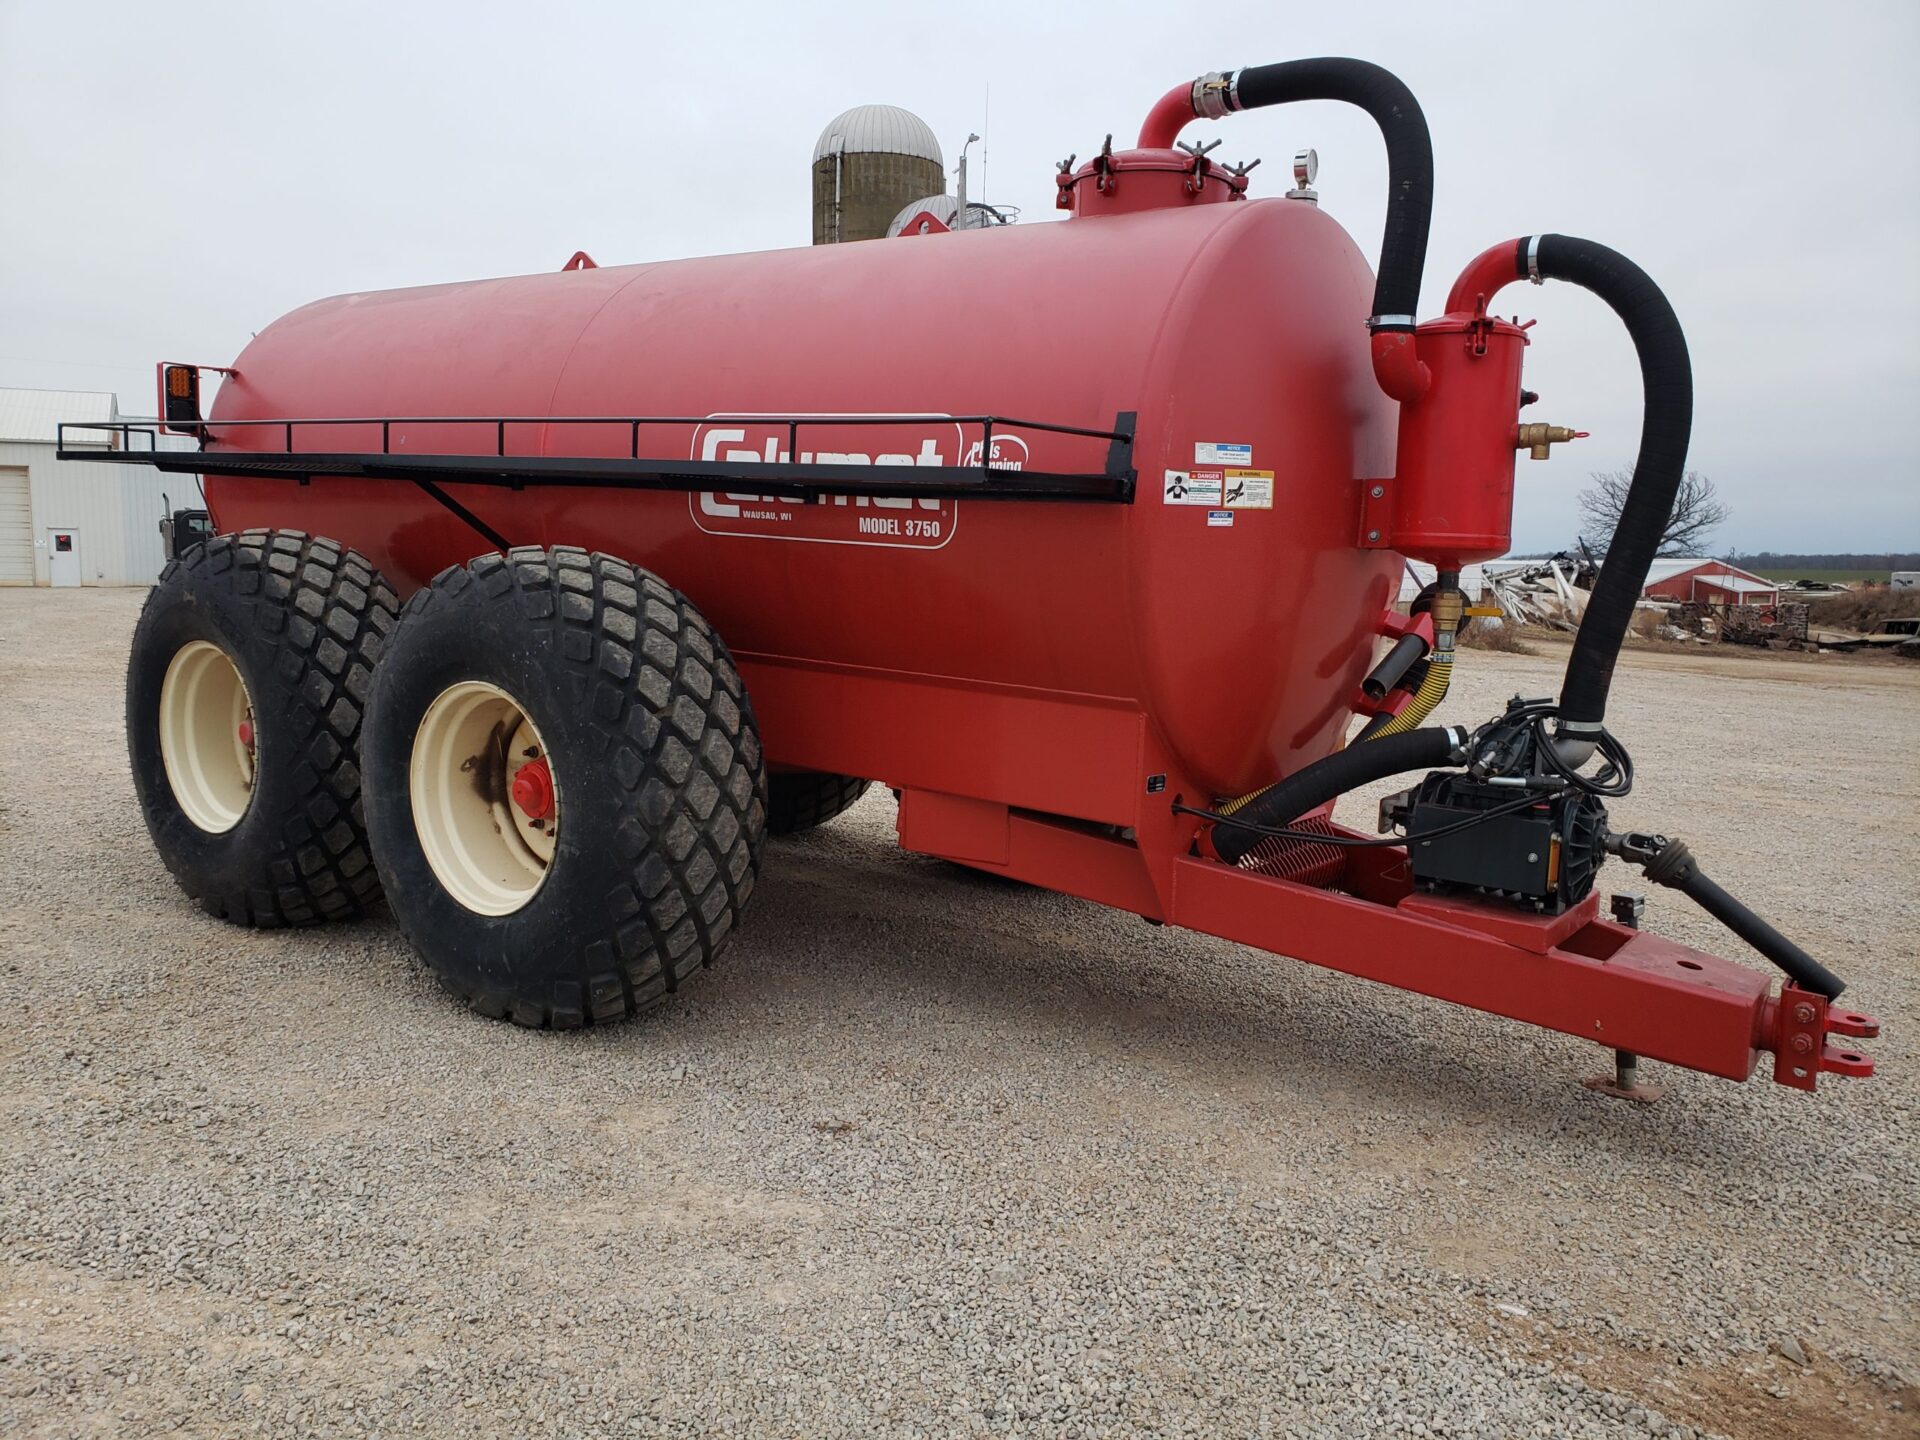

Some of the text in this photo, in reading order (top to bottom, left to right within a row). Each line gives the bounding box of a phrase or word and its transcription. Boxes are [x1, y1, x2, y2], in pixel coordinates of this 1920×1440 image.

[971, 440, 1001, 459] Phls
[743, 510, 792, 521] WAUSAU, WI
[859, 517, 941, 538] MODEL 3750
